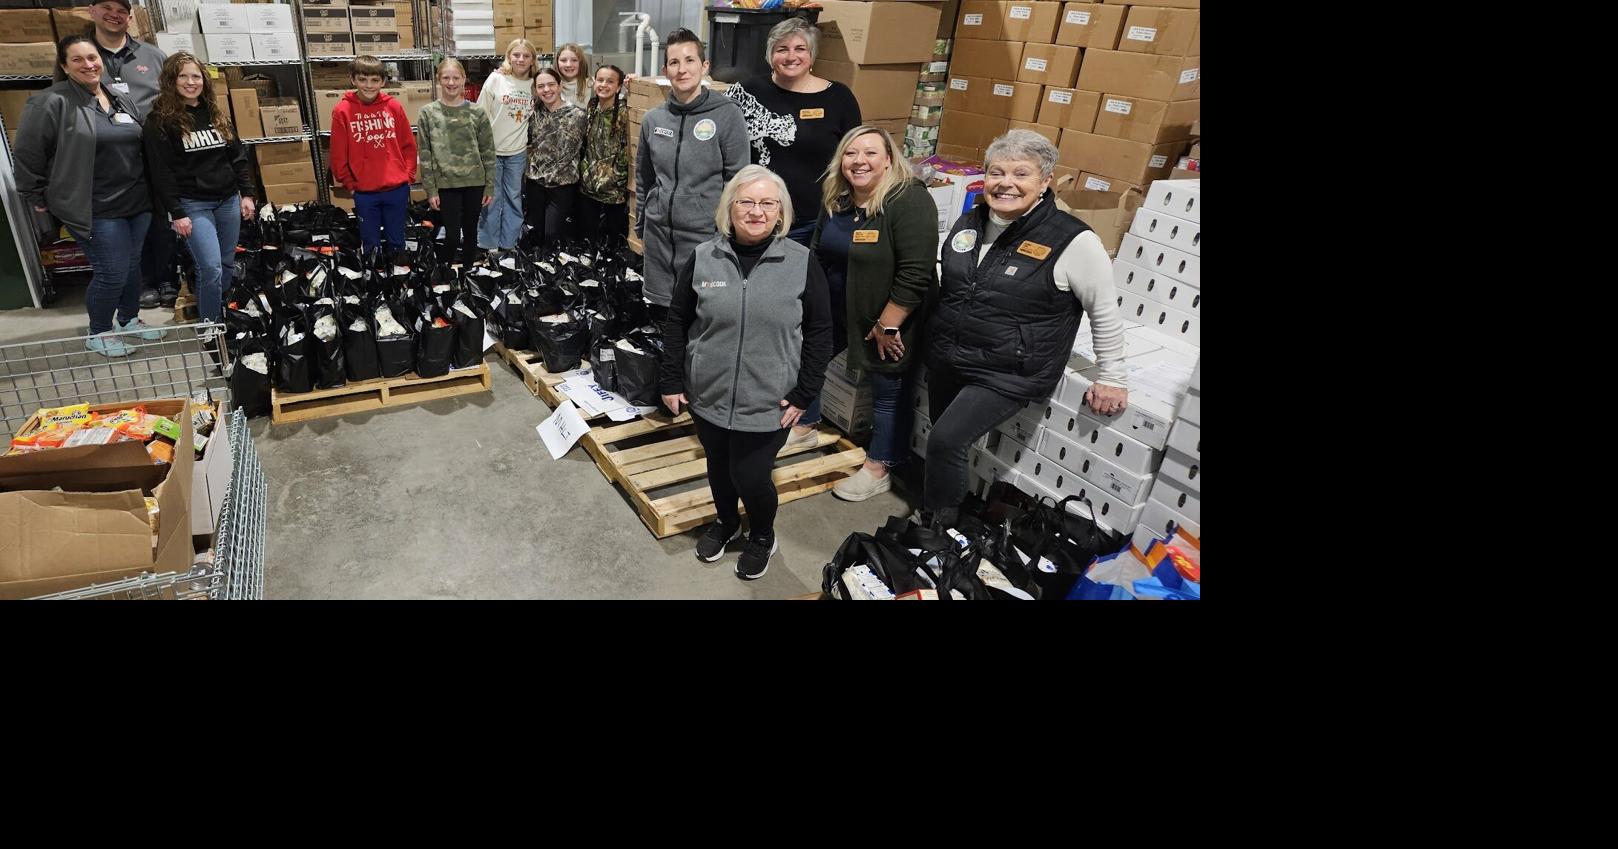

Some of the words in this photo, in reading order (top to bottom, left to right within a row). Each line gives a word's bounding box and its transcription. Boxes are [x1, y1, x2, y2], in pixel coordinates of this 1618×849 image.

[350, 117, 395, 133] FISHING
[181, 129, 226, 149] MHLT
[588, 383, 615, 401] JIFFY
[52, 413, 87, 422] Maruchan
